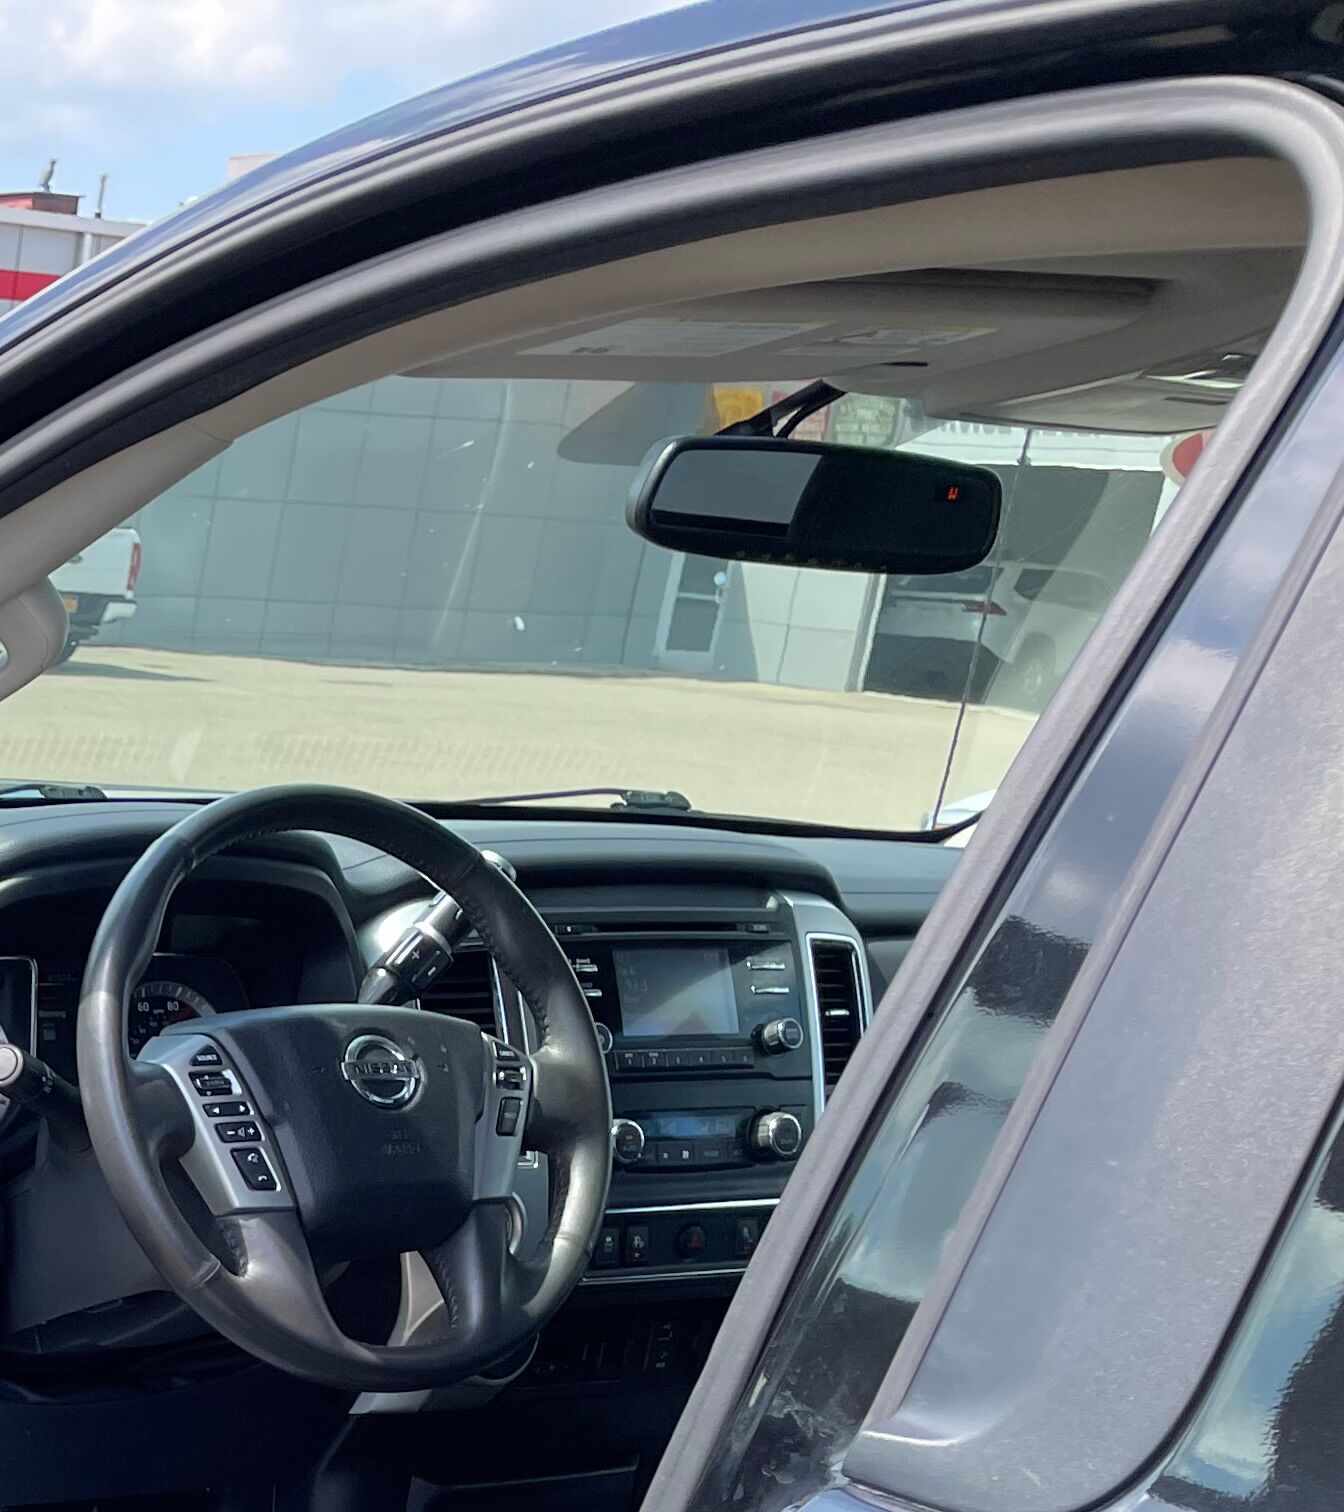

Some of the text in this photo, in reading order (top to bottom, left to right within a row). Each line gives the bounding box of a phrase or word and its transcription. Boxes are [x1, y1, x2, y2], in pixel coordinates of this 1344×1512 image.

[137, 1001, 179, 1012] 60 80
[354, 1062, 410, 1075] NISSAN
